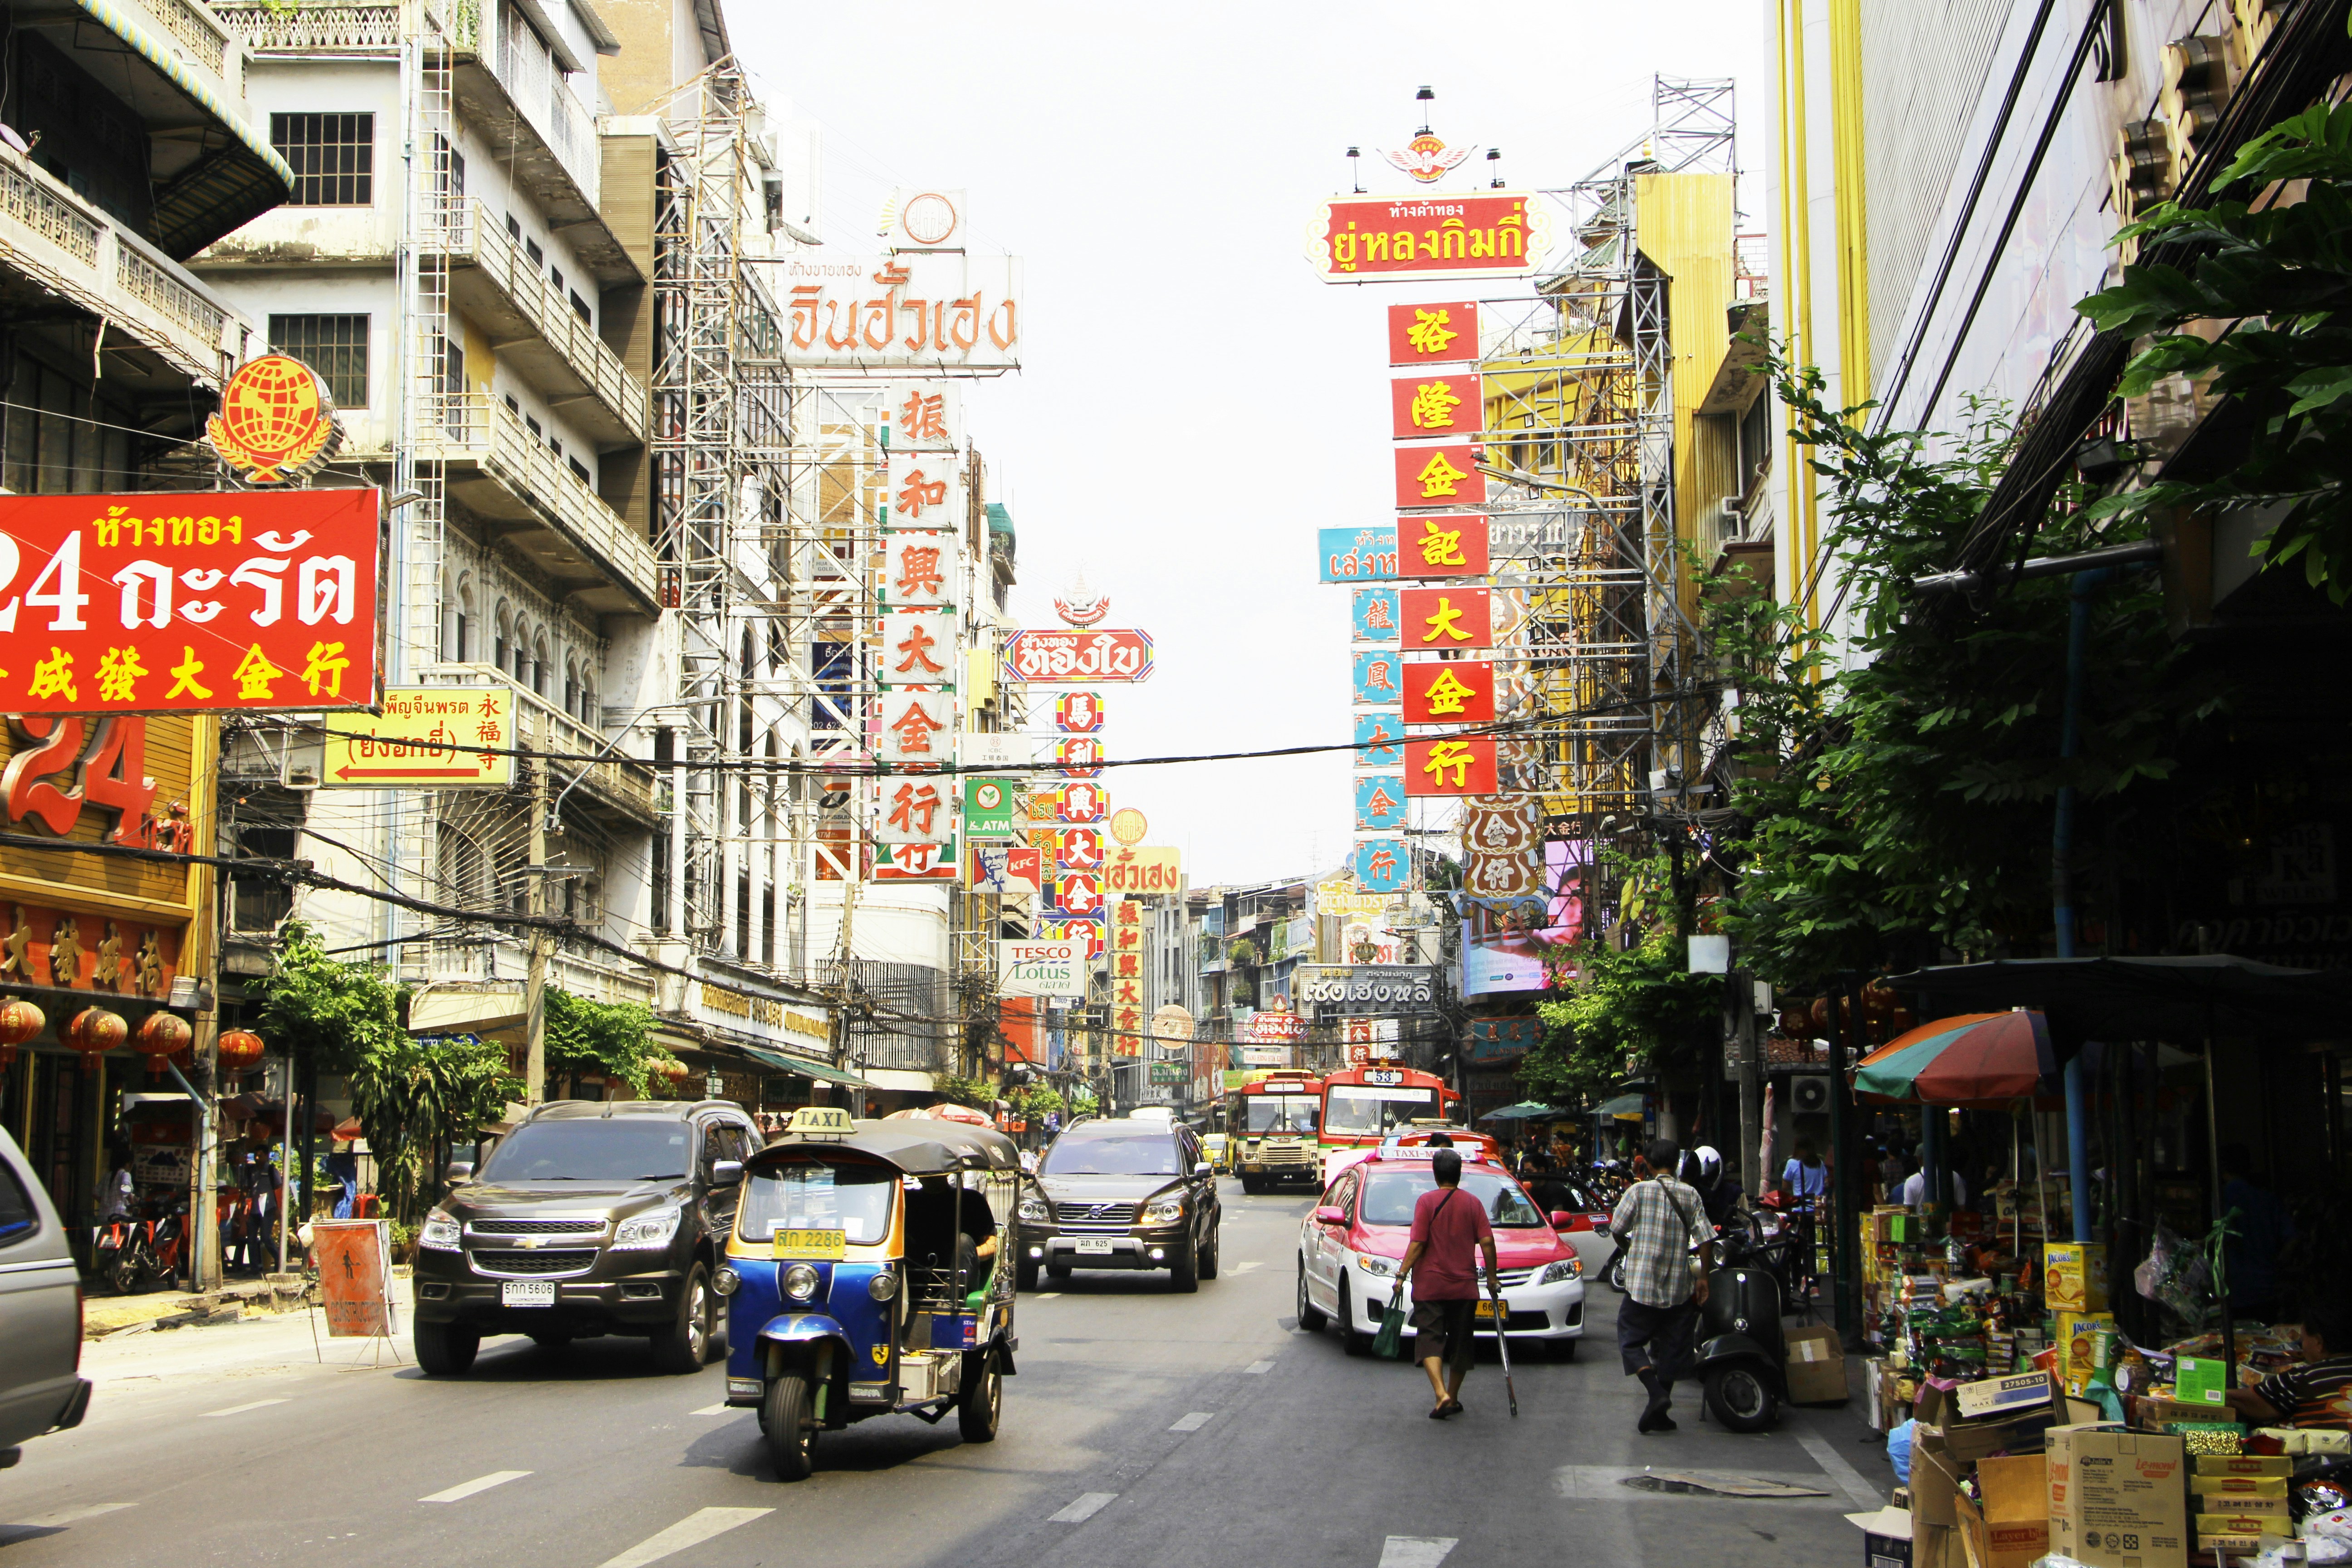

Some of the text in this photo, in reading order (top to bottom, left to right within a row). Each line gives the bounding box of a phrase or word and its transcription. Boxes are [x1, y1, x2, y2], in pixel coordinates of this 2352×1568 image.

[1412, 168, 1443, 179] TRADE MARK
[1389, 201, 1464, 218] ห้างค้าทอง
[1334, 202, 1522, 272] ยู่หลงกิมกี่
[789, 261, 862, 276] ห้างขายทอง
[93, 505, 242, 547] ห้างทอง
[112, 529, 356, 630] กะรัต
[888, 390, 949, 835] 振和興大金行
[1021, 633, 1078, 648] ห้างทอง
[1019, 634, 1140, 675] ทองใบ
[0, 641, 350, 703] 成發大金行
[382, 694, 469, 719] พ็ญจีนพรต
[475, 693, 501, 770] 永福寺
[1362, 598, 1397, 881] 龍鳳大金行
[982, 820, 1010, 831] ATM
[1010, 857, 1035, 872] KFC
[1011, 947, 1071, 959] TESCO
[1014, 965, 1070, 980] Lotus
[1117, 901, 1139, 1056] 振和興大金行
[1376, 1072, 1392, 1082] 53
[800, 1111, 843, 1127] TAXI
[805, 1232, 842, 1247] 2286
[529, 1284, 553, 1294] 5606
[1482, 1302, 1504, 1312] 665
[2005, 1376, 2044, 1388] 27505-10
[1972, 1399, 2001, 1407] MAXIM
[2136, 1458, 2176, 1470] Le-mond
[1994, 1531, 2026, 1542] Layer
